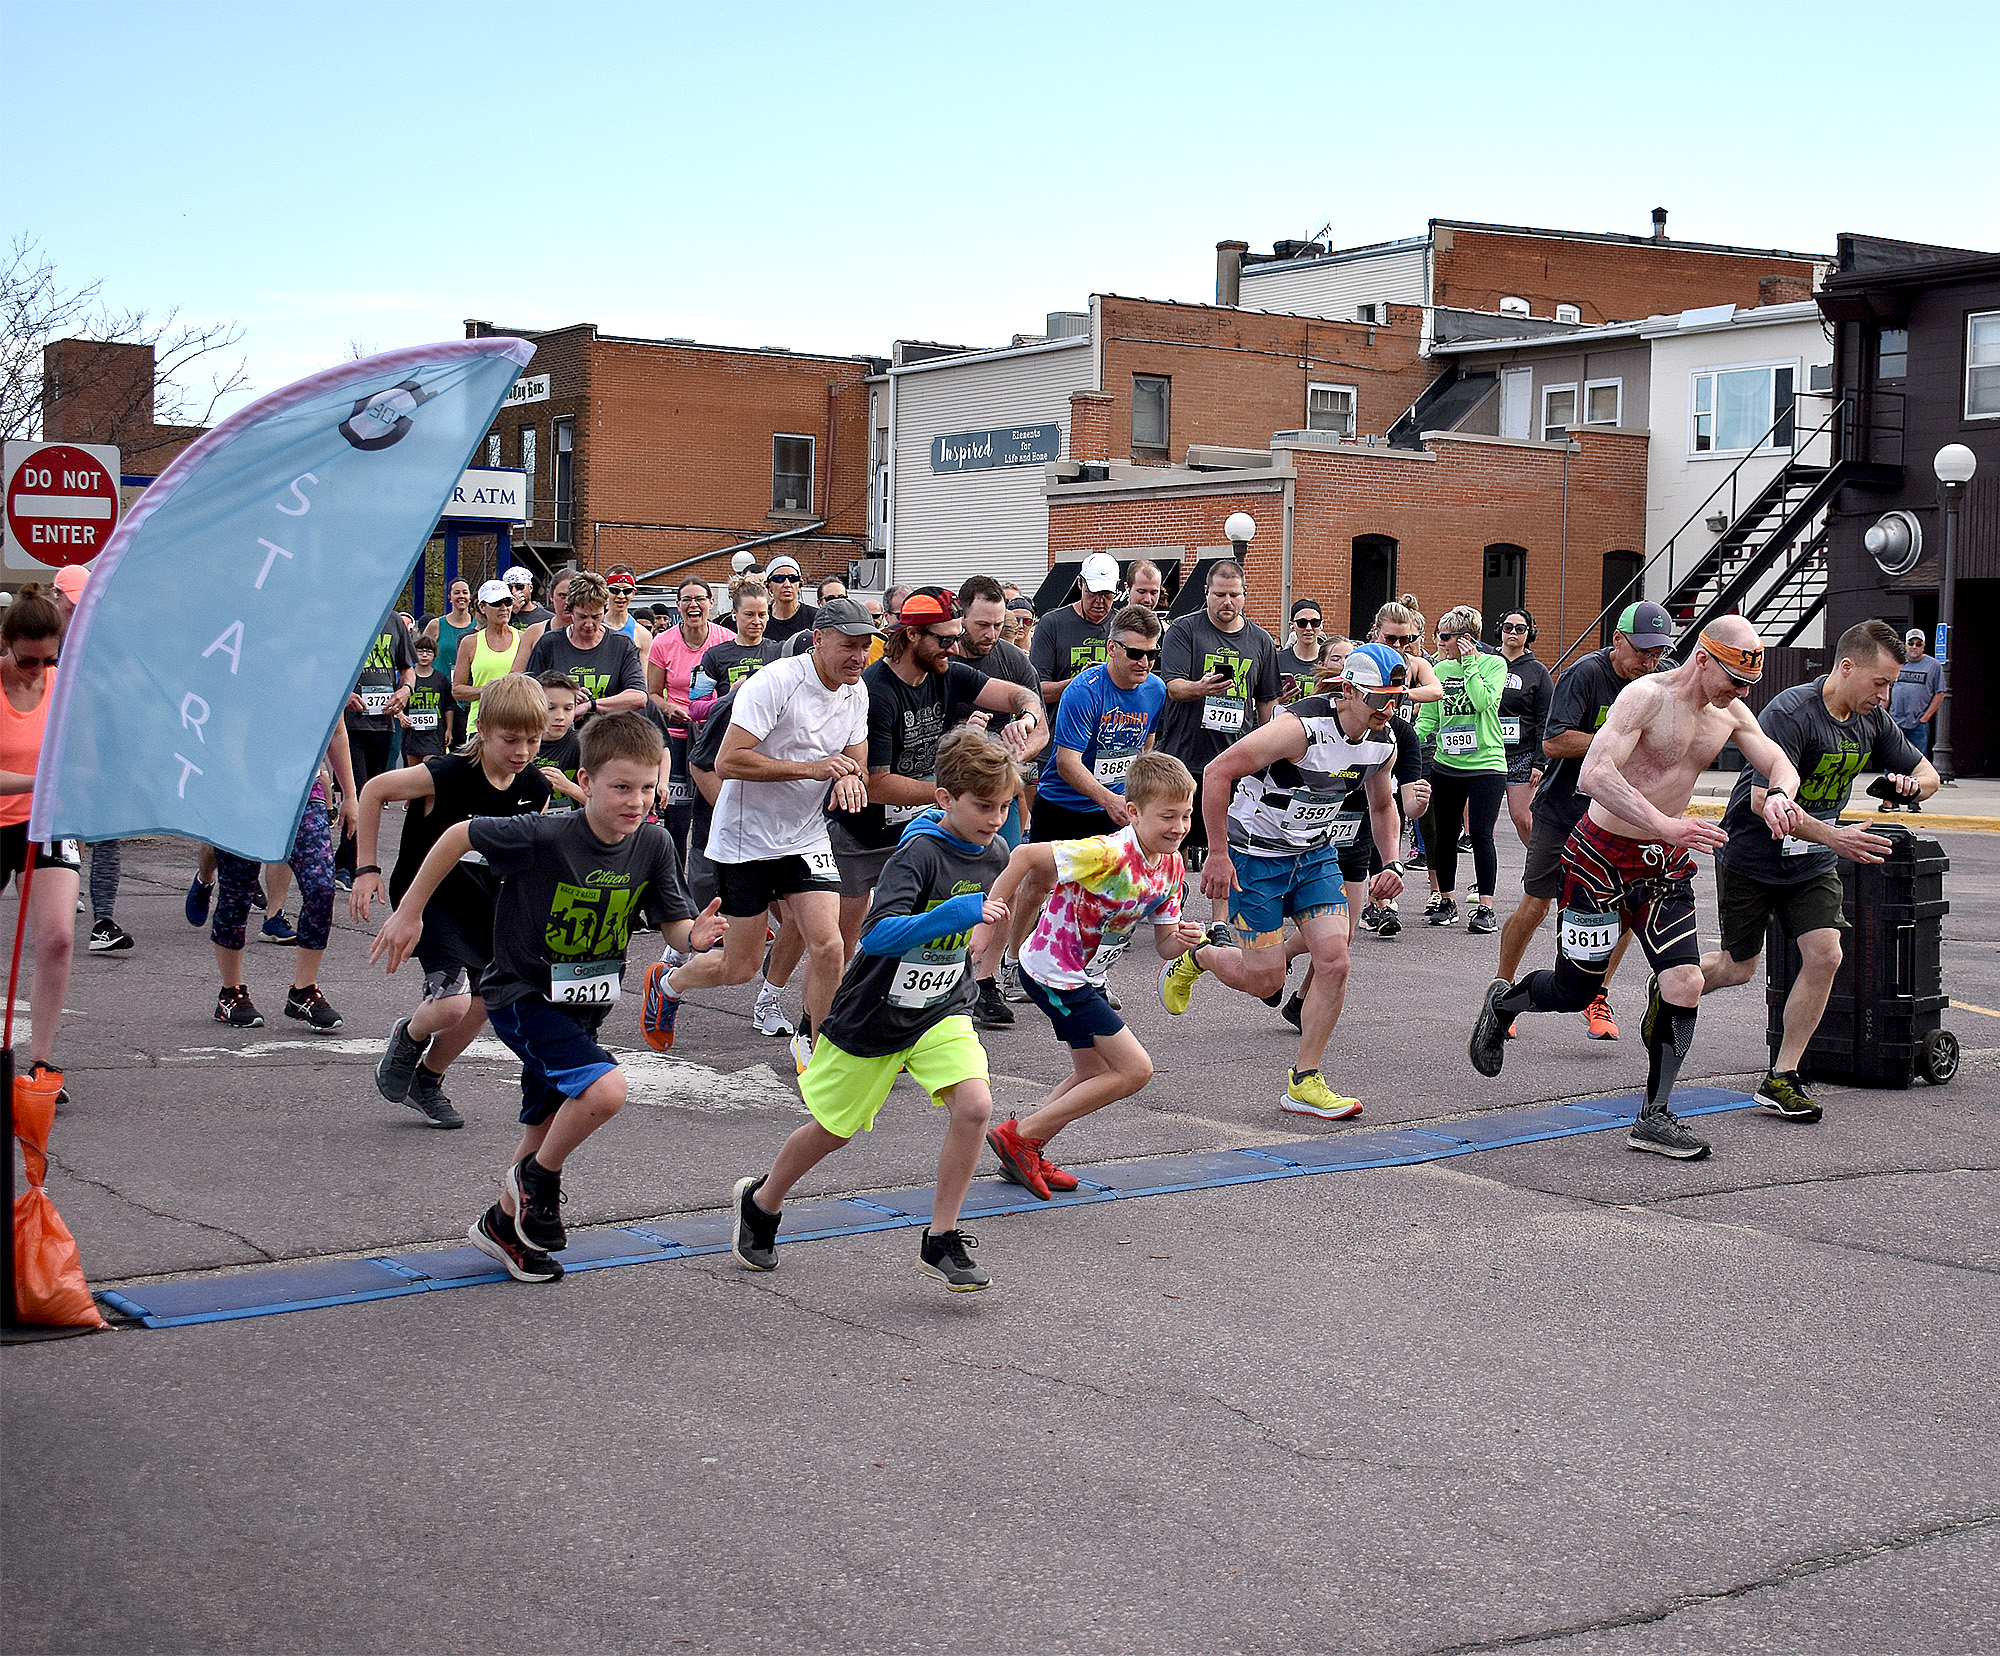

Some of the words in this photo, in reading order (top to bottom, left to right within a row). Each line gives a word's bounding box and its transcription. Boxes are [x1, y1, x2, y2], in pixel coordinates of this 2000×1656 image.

[1012, 429, 1041, 440] Elements
[940, 432, 994, 469] Inspired
[1020, 441, 1032, 451] for
[1004, 454, 1018, 464] Life
[1019, 452, 1031, 463] and
[1032, 451, 1048, 461] Home
[25, 468, 52, 488] DO
[63, 470, 101, 490] NOT
[452, 487, 467, 503] R
[472, 488, 517, 505] ATM
[32, 524, 95, 544] ENTER
[367, 696, 391, 707] 372
[412, 716, 434, 725] 3650
[1113, 712, 1149, 726] RAGNAR
[1208, 709, 1238, 724] 3701
[1502, 726, 1515, 736] 12
[1445, 734, 1472, 746] 3690
[1293, 806, 1336, 820] 3597
[1330, 824, 1353, 838] 671
[584, 869, 632, 884] Citizens
[560, 885, 574, 896] RACE
[575, 889, 580, 897] 2
[581, 891, 597, 899] RAISE
[545, 880, 649, 956] 5K
[1573, 914, 1605, 924] GOPHER
[1567, 928, 1611, 948] 3611
[921, 951, 957, 962] GOPHER
[573, 964, 607, 977] GOPHER
[903, 969, 957, 993] 3644
[563, 981, 611, 1003] 3612
